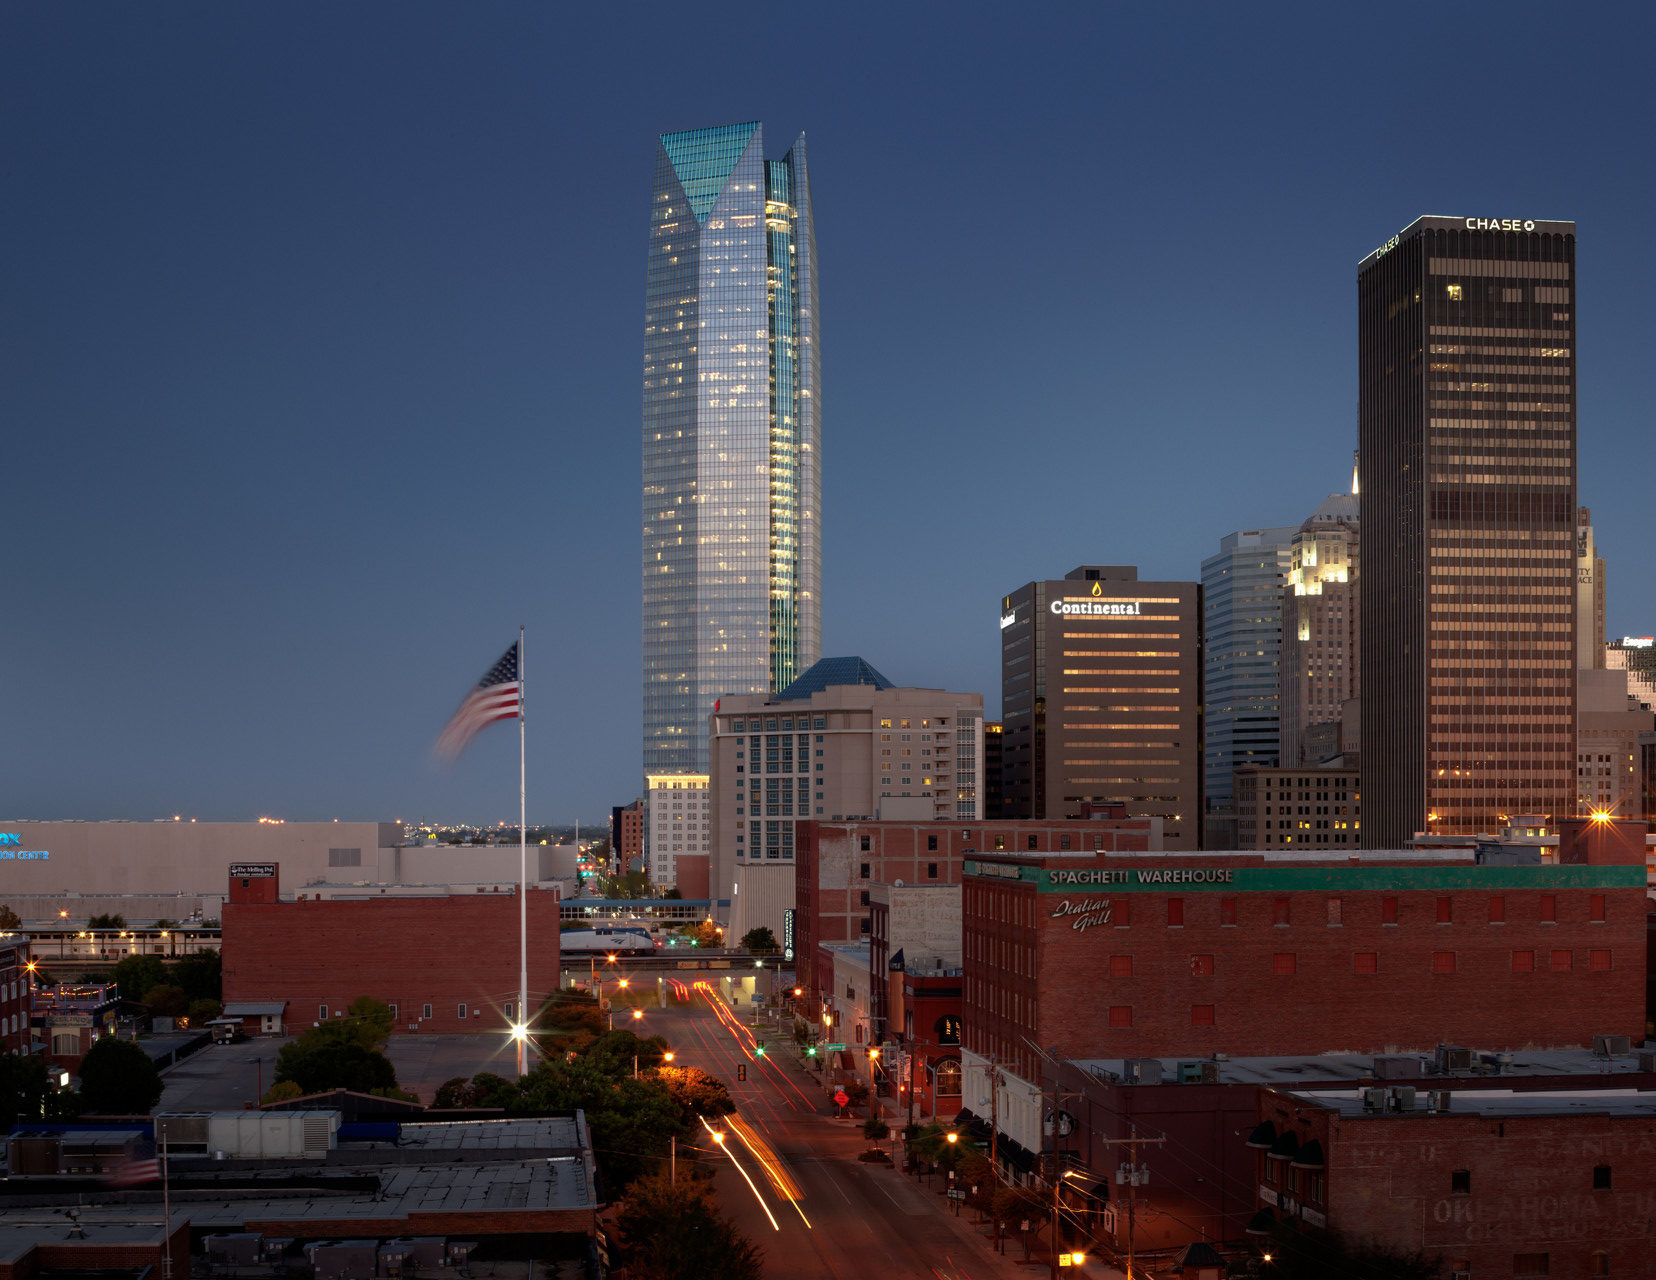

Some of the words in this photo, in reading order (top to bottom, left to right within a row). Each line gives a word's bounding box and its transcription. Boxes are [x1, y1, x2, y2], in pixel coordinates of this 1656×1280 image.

[1466, 217, 1522, 231] CHASE
[1376, 237, 1395, 259] CHASE
[1050, 600, 1140, 615] Continental
[17, 850, 50, 860] CENTER
[1050, 870, 1129, 885] SPAGHETTI
[1137, 868, 1233, 883] WAREHOUSE
[1050, 898, 1110, 918] Italian
[1072, 910, 1111, 933] Grill
